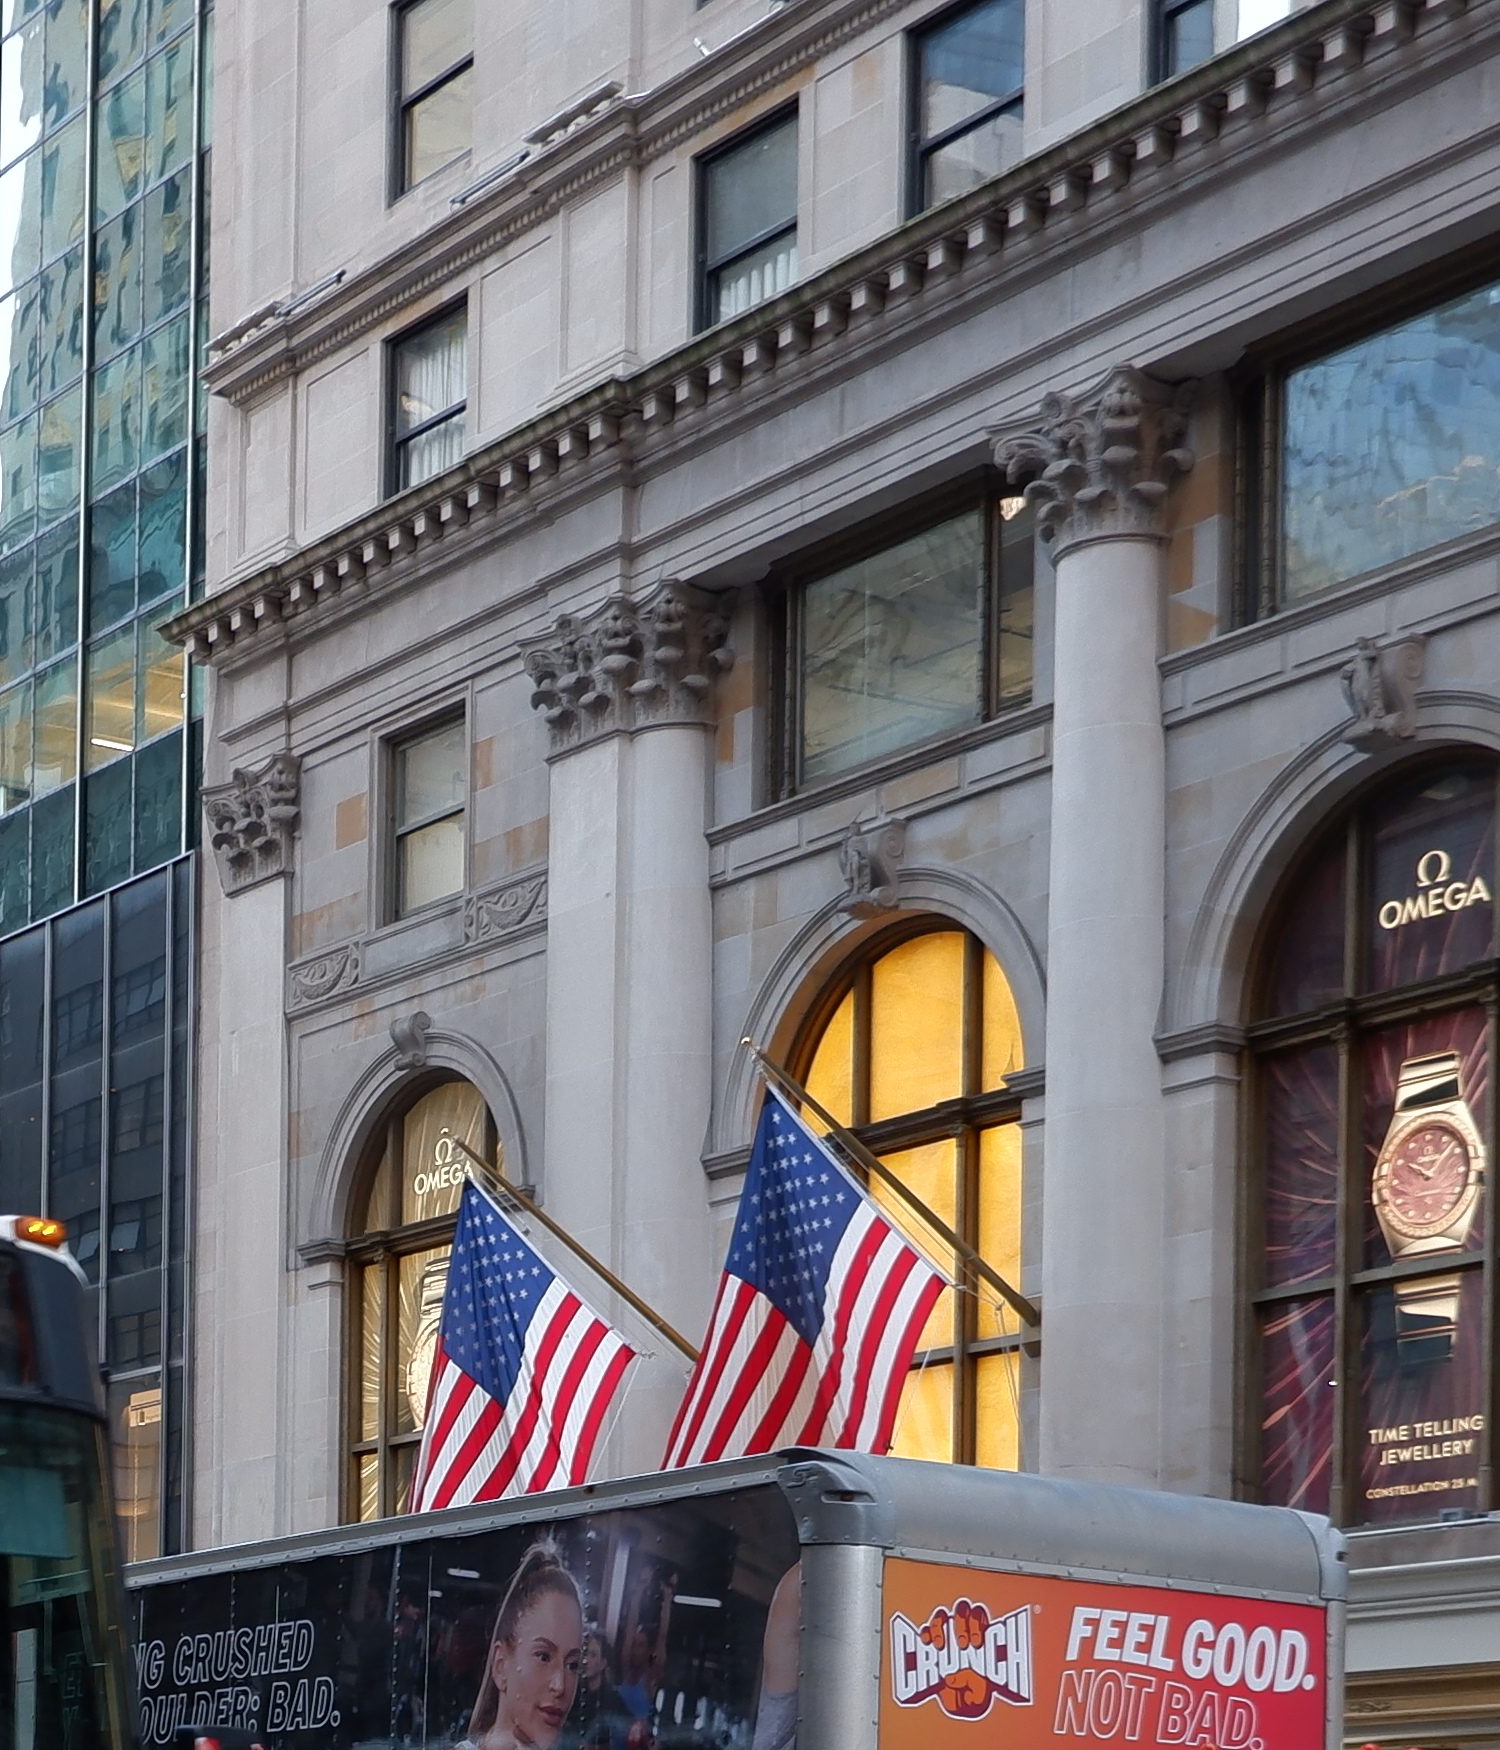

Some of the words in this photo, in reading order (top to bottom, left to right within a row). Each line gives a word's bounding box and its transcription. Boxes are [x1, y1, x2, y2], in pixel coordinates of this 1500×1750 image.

[1379, 876, 1491, 930] OMEGA
[414, 1160, 474, 1195] OMEGA
[1368, 1425, 1411, 1445] TIME
[1413, 1415, 1485, 1438] TELLING
[1380, 1439, 1475, 1466] JEWELLERY
[1366, 1480, 1449, 1499] CONSTELLATION
[173, 1619, 315, 1686] CRUSHED
[890, 1606, 1034, 1704] CRUNCH
[1065, 1606, 1176, 1671] FEEL
[1182, 1619, 1318, 1692] GOOD.
[267, 1676, 342, 1733] BAD.
[1053, 1669, 1156, 1740] NOT
